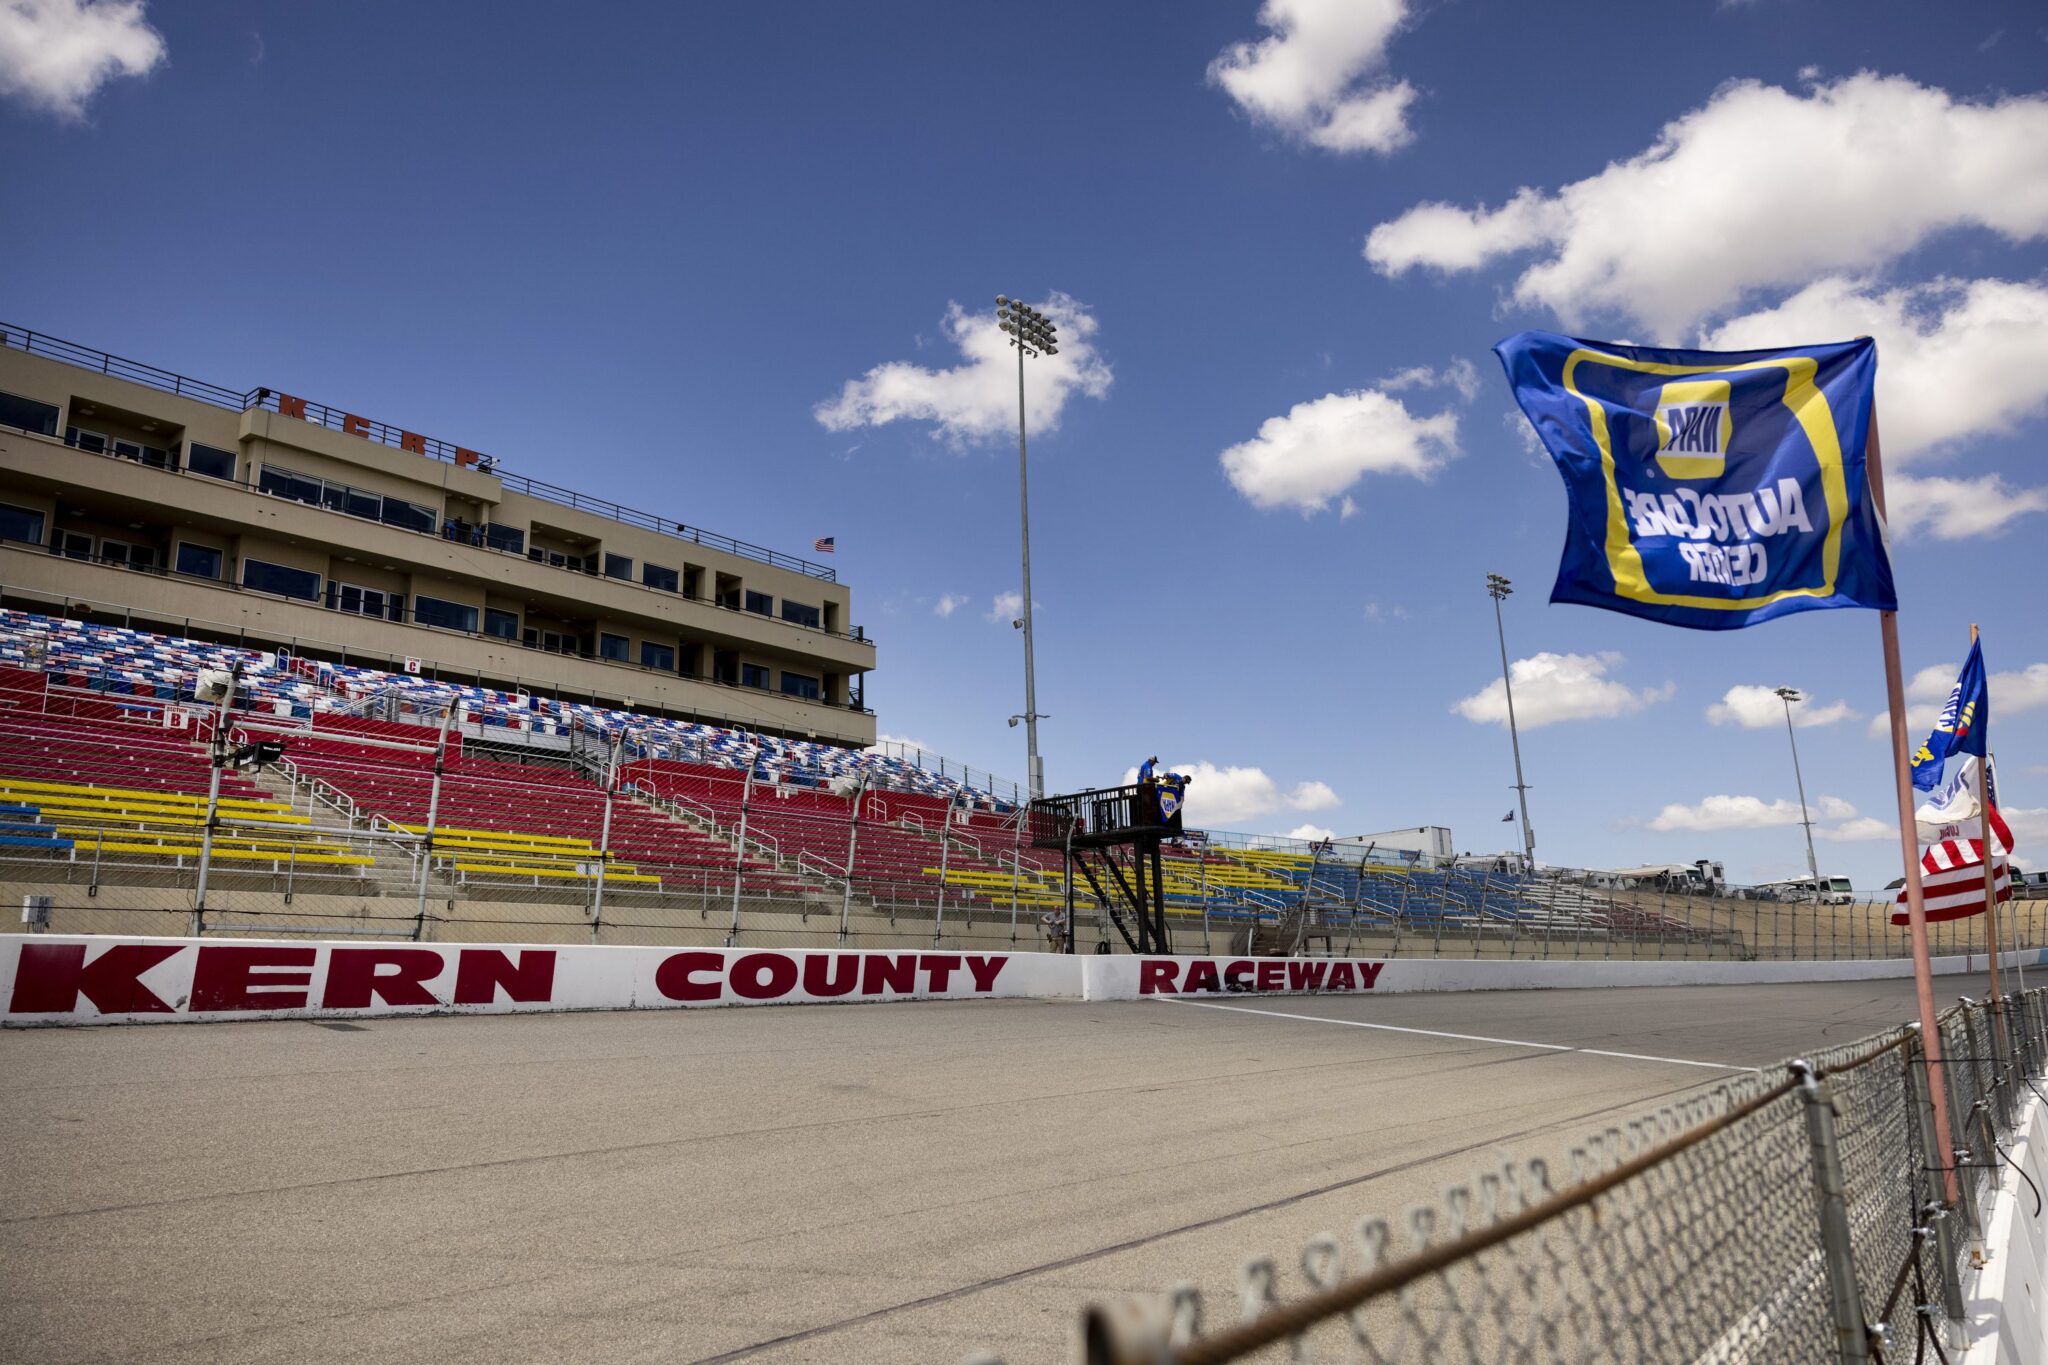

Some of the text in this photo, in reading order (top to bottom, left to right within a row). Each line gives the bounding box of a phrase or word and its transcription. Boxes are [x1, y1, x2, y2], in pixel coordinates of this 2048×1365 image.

[171, 713, 181, 727] B
[9, 944, 1385, 1014] KERN COUNTY RACEWAY
